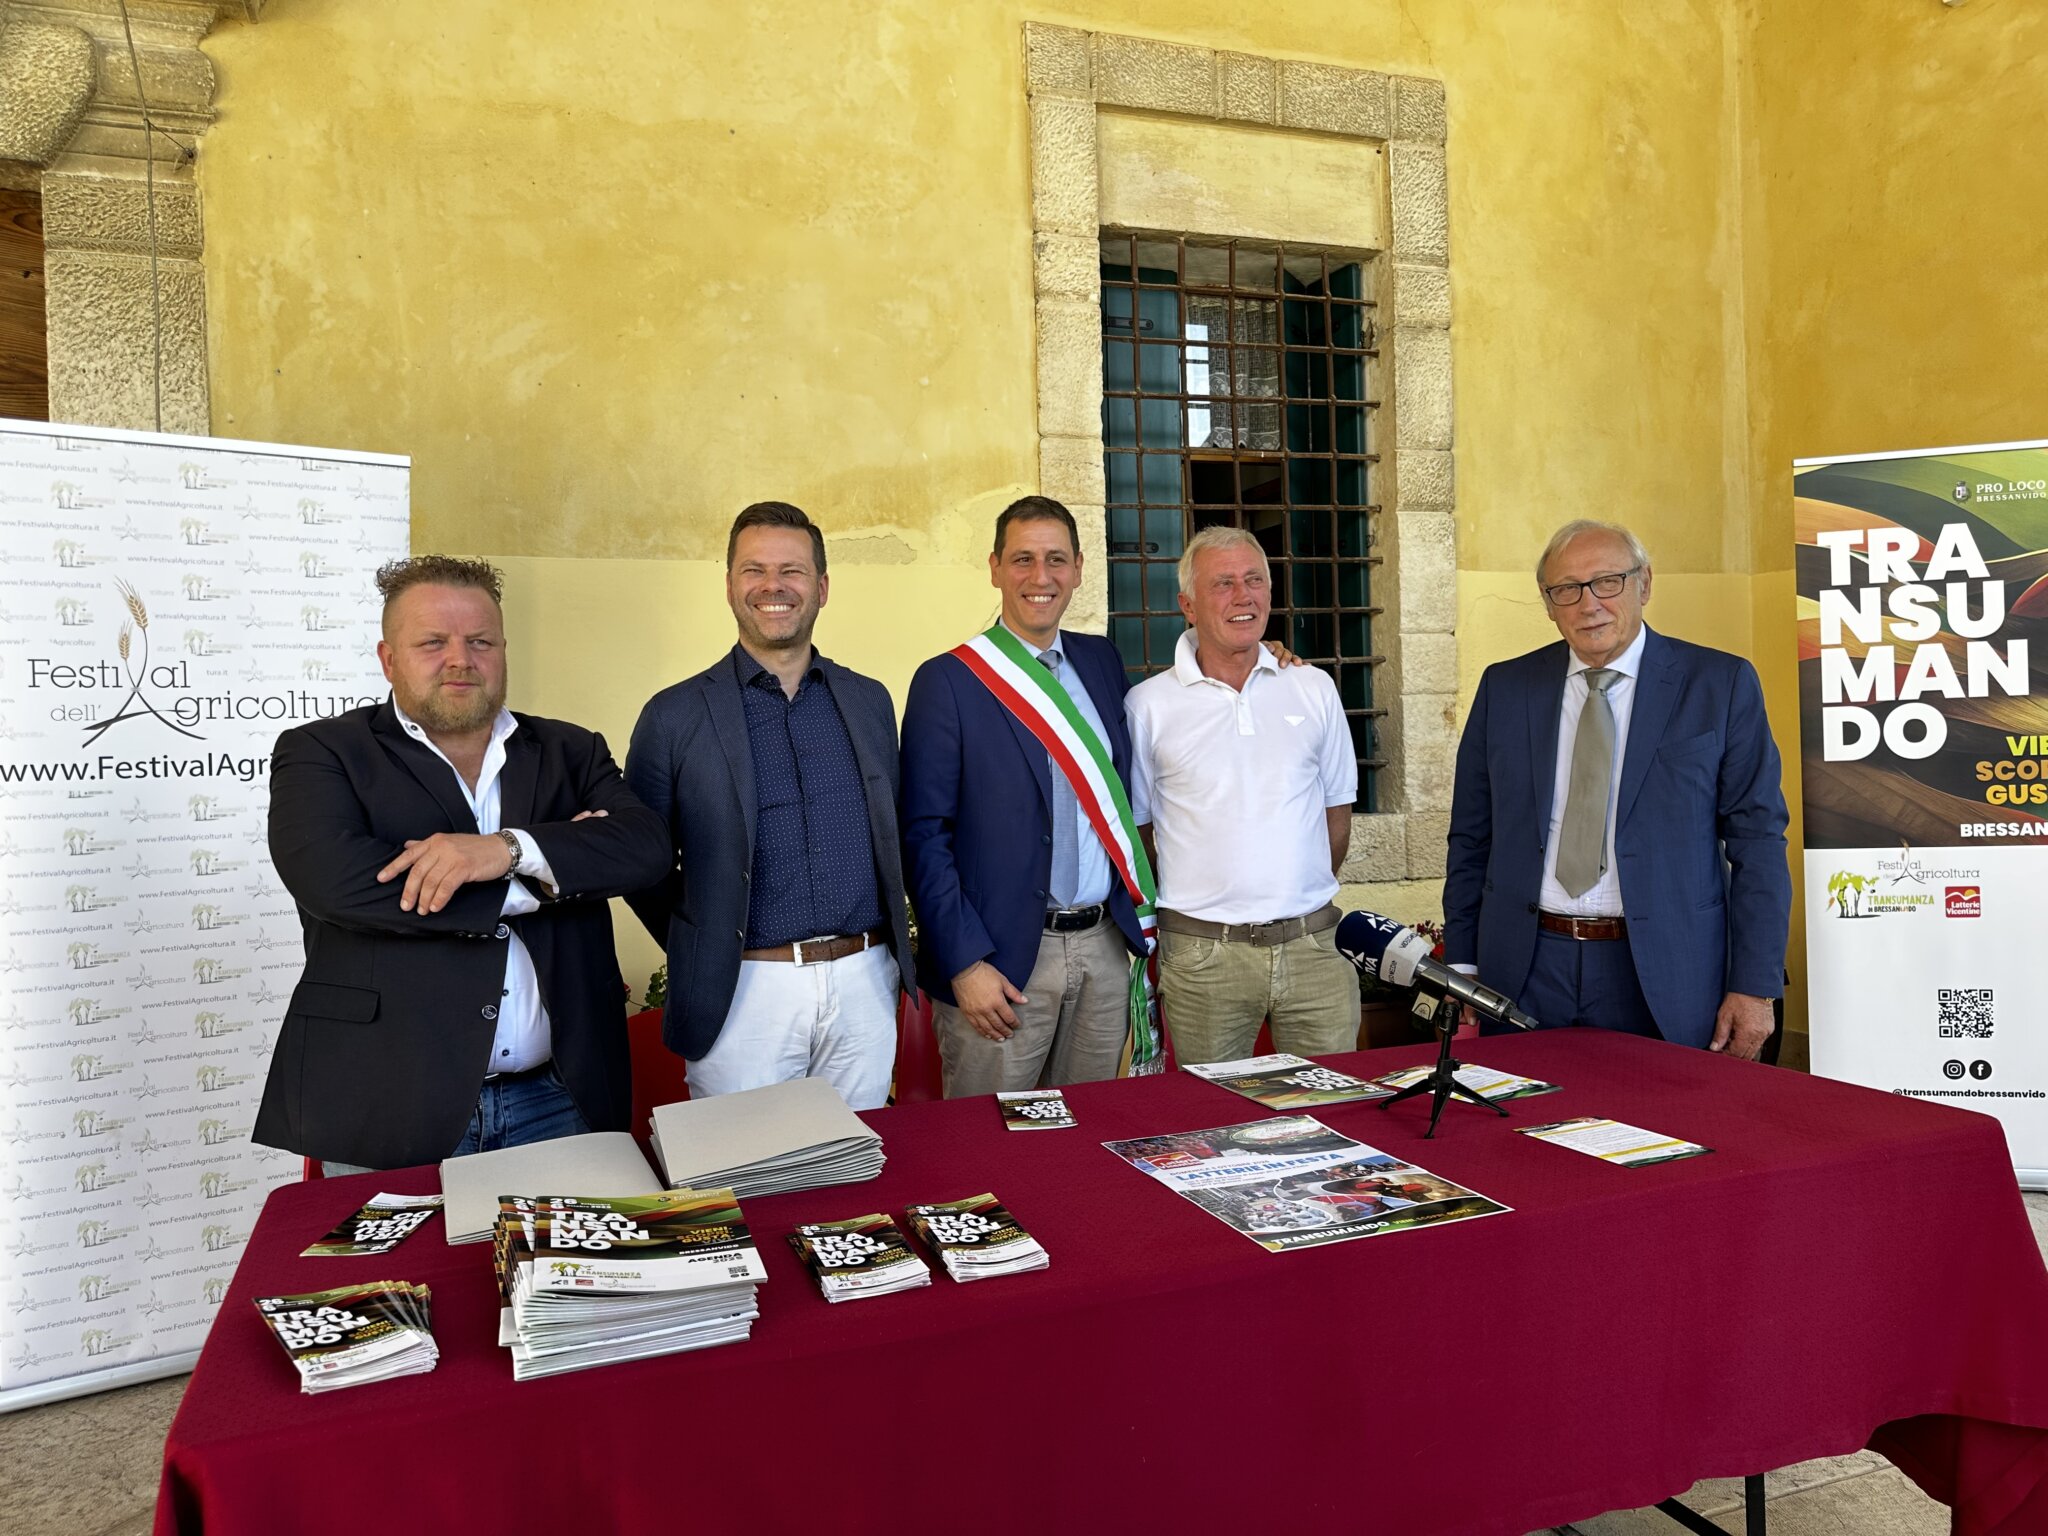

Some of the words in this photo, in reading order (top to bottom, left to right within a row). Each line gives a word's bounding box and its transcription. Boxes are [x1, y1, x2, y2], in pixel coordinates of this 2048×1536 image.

[1976, 483, 2003, 493] PRO
[2009, 481, 2047, 491] LOCO
[1976, 492, 2047, 502] BRESSANVIDO
[1816, 522, 1991, 587] TRA
[1819, 579, 2006, 646] NSU
[1821, 638, 2031, 704] MAN
[1822, 702, 1948, 762] DO
[1868, 895, 1935, 905] TRANSUMANZA
[140, 940, 236, 954] www.FestivalAgricoltura.it
[142, 994, 238, 1009] www.FestivalAgricoltura.it
[144, 1047, 239, 1064] www.FestivalAgricoltura.it
[16, 1090, 119, 1108] www.FestivalAgricoltura.it
[145, 1100, 240, 1119] www.FestivalAgricoltura.it
[147, 1153, 242, 1173] www.FestivalAgricoltura.it
[1176, 1166, 1264, 1181] LATTERIE
[1286, 1153, 1345, 1165] FESTA
[549, 1197, 577, 1205] 26
[20, 1199, 123, 1222] www.FestivalAgricoltura.it
[148, 1205, 244, 1227] www.FestivalAgricoltura.it
[550, 1210, 630, 1222] TRA
[923, 1212, 979, 1224] TRA
[550, 1219, 638, 1231] NSU
[927, 1216, 988, 1230] NSU
[932, 1221, 1002, 1238] MAN
[550, 1228, 650, 1241] MAN
[807, 1232, 867, 1245] TRA
[937, 1234, 980, 1243] DO
[1271, 1221, 1390, 1245] TRANSUMANDO
[550, 1238, 612, 1250] DO
[812, 1237, 875, 1253] NSU
[817, 1242, 889, 1260] MAN
[688, 1252, 743, 1263] AGENDA
[821, 1256, 866, 1268] DO
[22, 1254, 124, 1278] www.FestivalAgricoltura.it
[259, 1298, 285, 1306] 26
[24, 1308, 126, 1333] www.FestivalAgricoltura.it
[267, 1306, 344, 1322] TRA
[274, 1311, 353, 1332] NSU
[278, 1316, 371, 1341] MAN
[286, 1333, 342, 1350] DO
